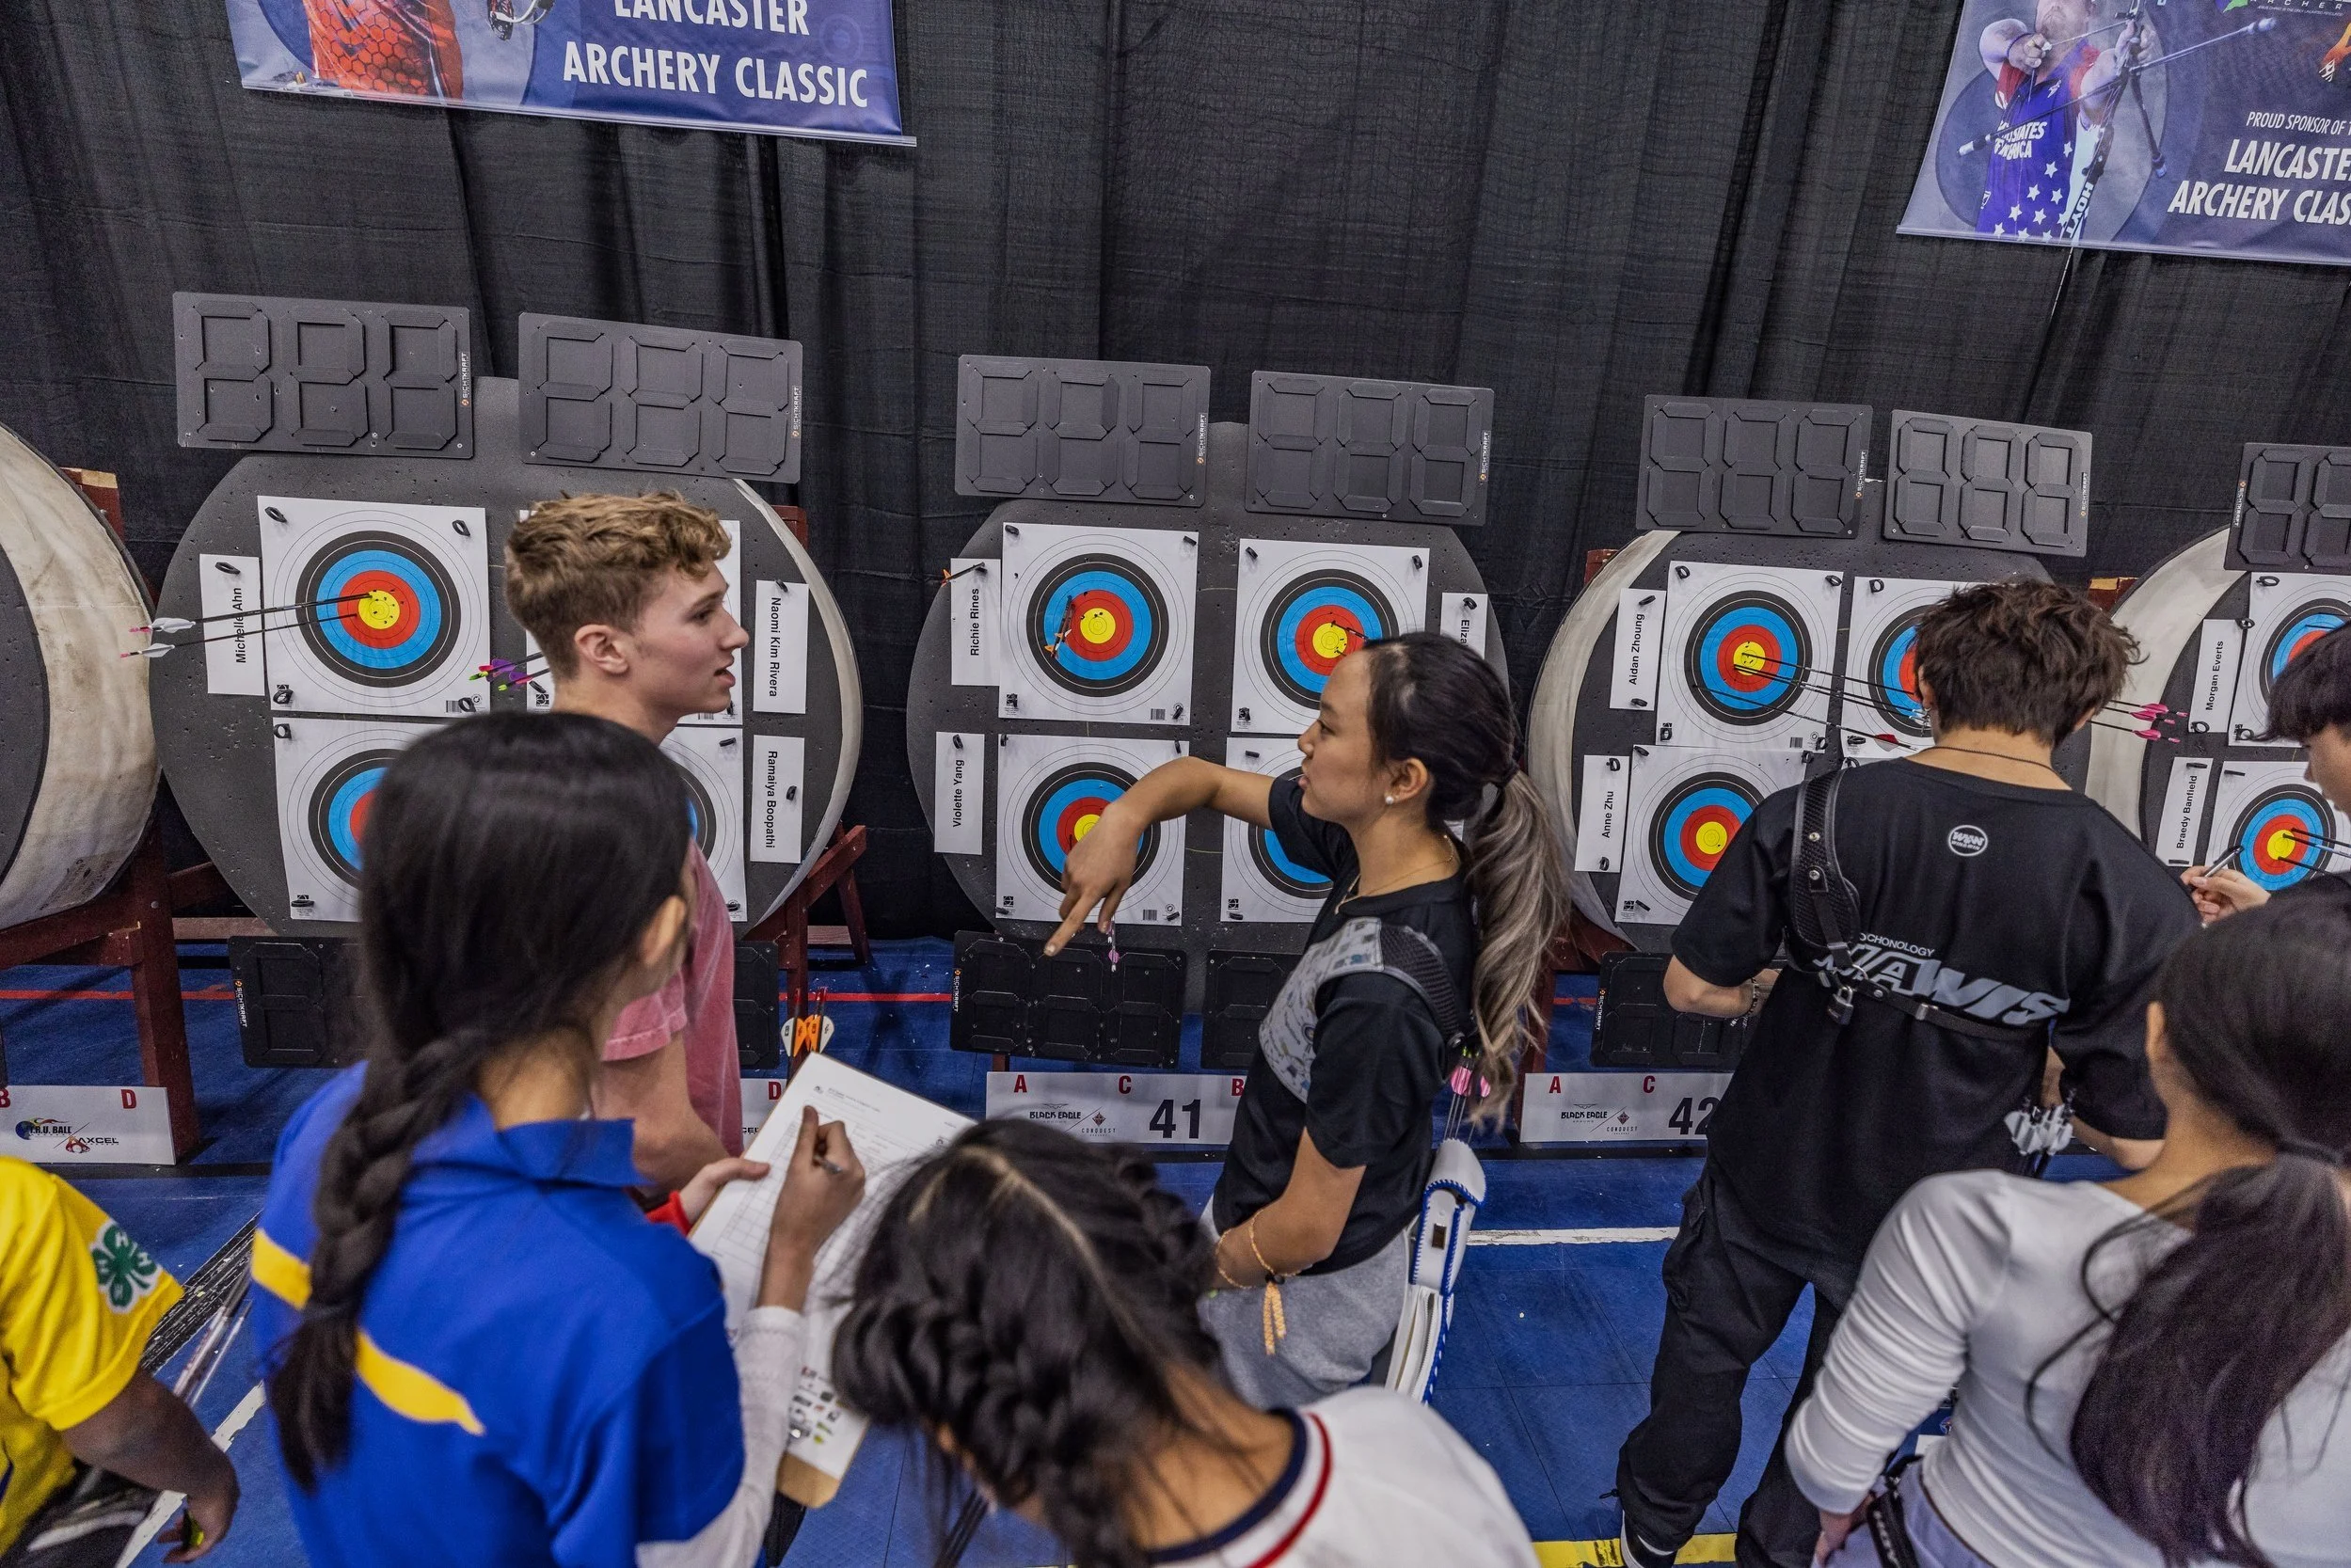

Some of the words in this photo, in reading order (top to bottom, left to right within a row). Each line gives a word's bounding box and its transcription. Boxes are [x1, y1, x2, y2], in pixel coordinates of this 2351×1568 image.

[563, 40, 721, 94] ARCHERY
[735, 56, 867, 107] CLASSIC
[2246, 111, 2285, 129] PROUD
[2285, 114, 2330, 134] SPONSOR
[2330, 119, 2346, 135] OF
[2224, 138, 2351, 182] LANCASTE
[2167, 181, 2291, 221] ARCHERY
[2293, 189, 2351, 226] CLAS
[231, 587, 243, 611] Ahn
[970, 588, 979, 619] Rines
[770, 597, 782, 633] Naomi
[233, 612, 246, 663] Michelle
[770, 637, 781, 658] Kim
[970, 622, 979, 657] Richie
[1460, 619, 1469, 647] Eliza
[1631, 613, 1645, 653] Zhoung
[769, 661, 780, 697] Rivera
[1628, 656, 1639, 686] Aidan
[2205, 674, 2218, 711] Morgan
[2213, 641, 2224, 672] Everts
[765, 751, 778, 797] Ramaiya
[953, 759, 965, 785] Yang
[953, 788, 962, 828] Violette
[1604, 791, 1614, 810] Zhu
[2183, 775, 2198, 814] Banfield
[764, 800, 777, 847] Boopathi
[1601, 813, 1612, 838] Anne
[2176, 816, 2191, 848] Braedy
[0, 1088, 11, 1108] B
[769, 1081, 782, 1101] D
[1013, 1074, 1027, 1093] A
[1118, 1075, 1132, 1094] C
[1231, 1078, 1245, 1096] B
[1549, 1075, 1562, 1093] A
[1643, 1075, 1656, 1093] C
[120, 1089, 137, 1109] D
[53, 1125, 71, 1134] BALL
[1029, 1111, 1056, 1119] BLACK
[1057, 1111, 1082, 1119] EAGLE
[1149, 1099, 1201, 1139] 41
[1561, 1111, 1585, 1119] BLACK
[1668, 1097, 1721, 1135] 42
